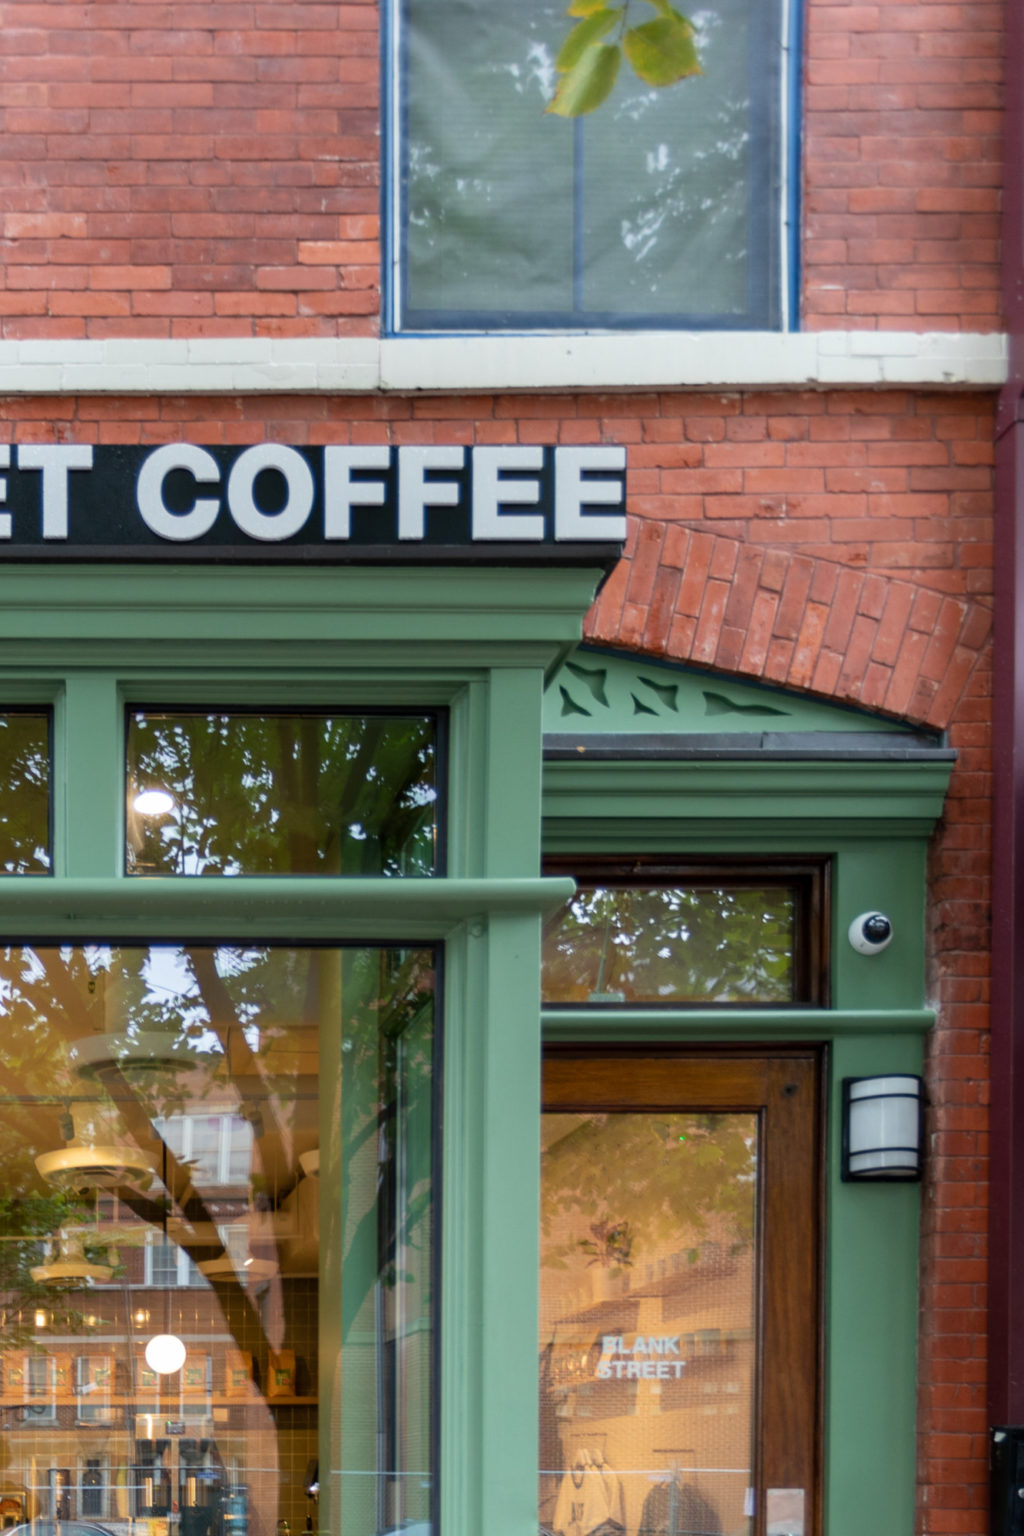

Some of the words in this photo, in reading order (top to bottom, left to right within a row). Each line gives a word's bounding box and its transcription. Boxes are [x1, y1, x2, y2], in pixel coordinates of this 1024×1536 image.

[136, 442, 627, 541] COFFEE
[602, 1336, 680, 1354] BLANK
[597, 1361, 686, 1379] STREET
